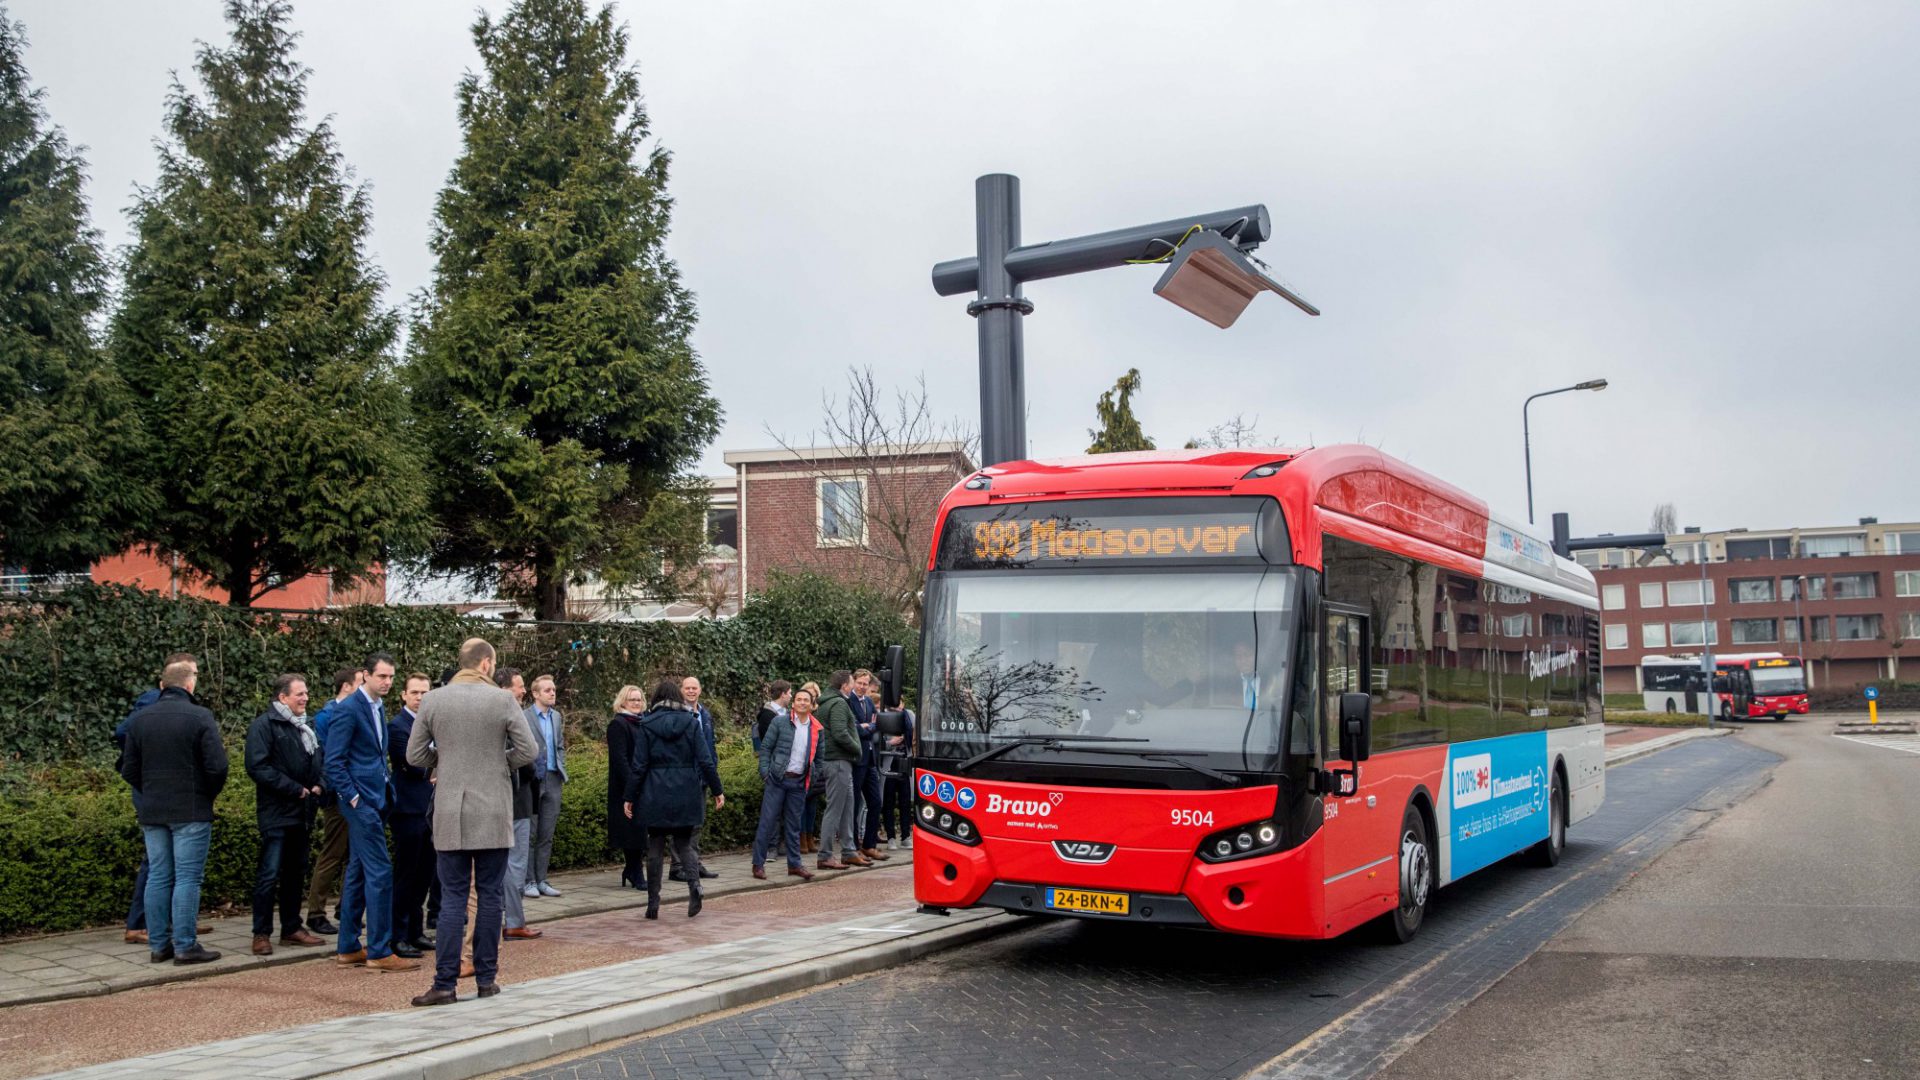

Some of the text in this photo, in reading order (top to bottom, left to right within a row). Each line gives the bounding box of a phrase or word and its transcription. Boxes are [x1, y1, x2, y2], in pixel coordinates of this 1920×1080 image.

[1031, 518, 1250, 557] Maasoever
[1457, 769, 1476, 795] 100%
[986, 794, 1051, 816] Bravo
[1171, 808, 1214, 827] 9504
[1062, 843, 1104, 856] VDL
[1057, 891, 1124, 910] 24-BKN-4
